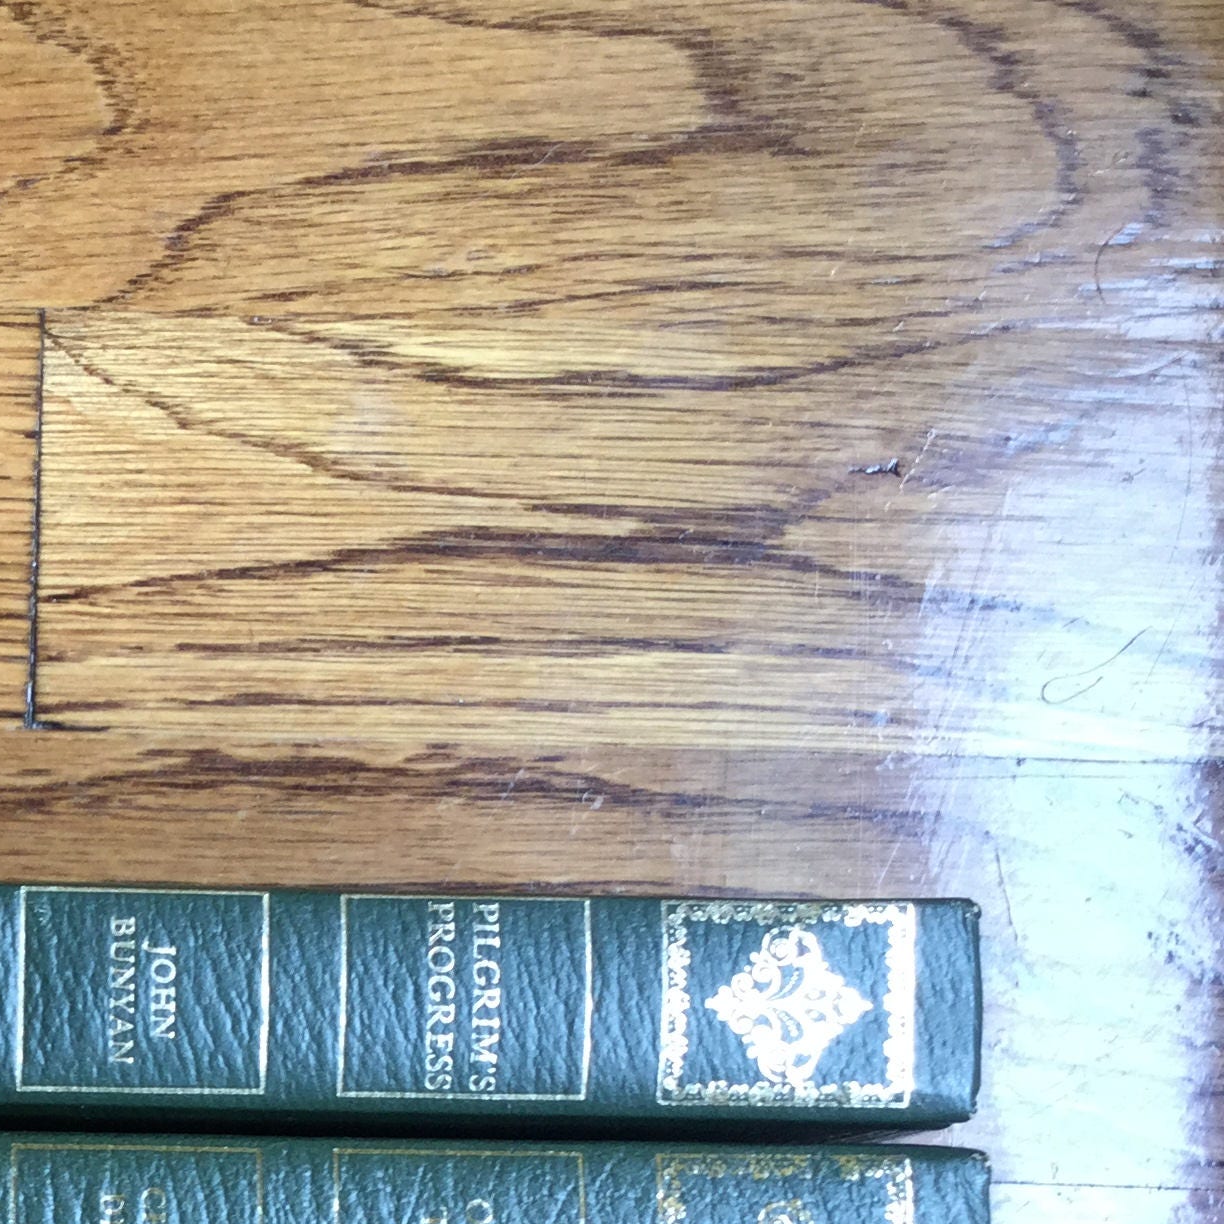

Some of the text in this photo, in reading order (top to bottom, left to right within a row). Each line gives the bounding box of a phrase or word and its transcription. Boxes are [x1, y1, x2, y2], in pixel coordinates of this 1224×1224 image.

[107, 915, 136, 1064] BUNYAN
[141, 936, 176, 1039] JOHN
[424, 901, 456, 1090] PROGRESS
[468, 902, 501, 1091] PILGRIM'S
